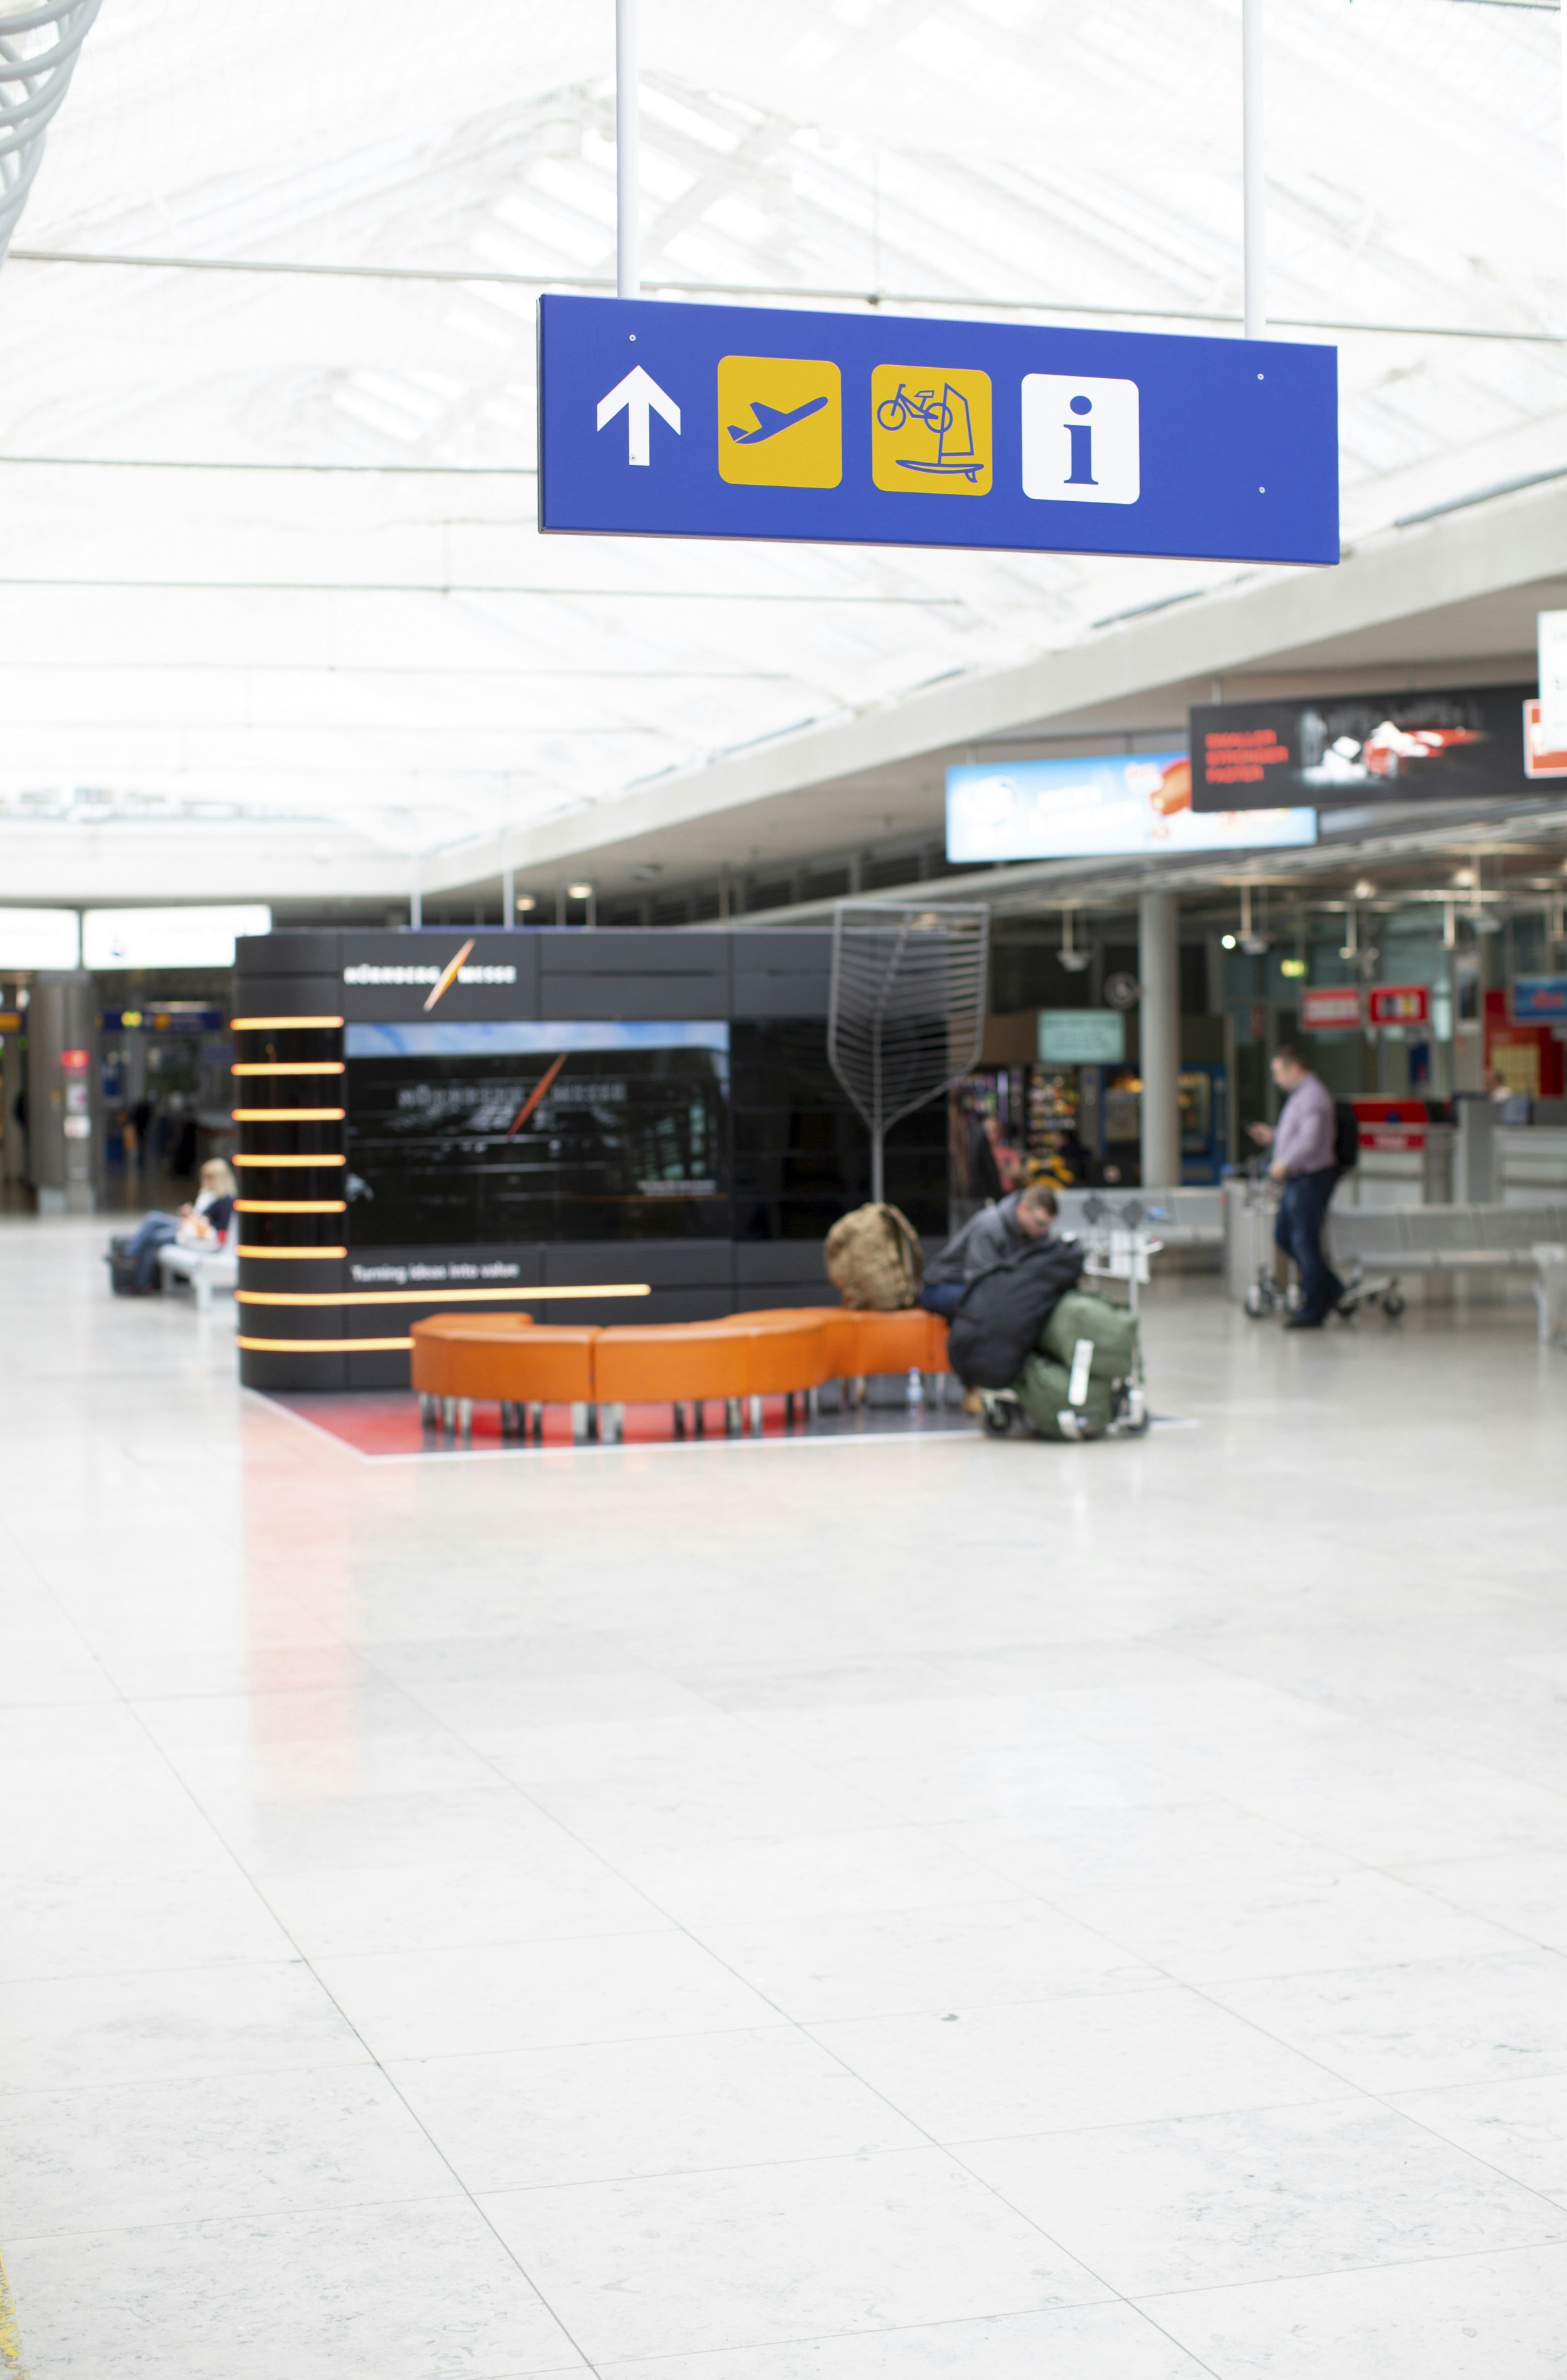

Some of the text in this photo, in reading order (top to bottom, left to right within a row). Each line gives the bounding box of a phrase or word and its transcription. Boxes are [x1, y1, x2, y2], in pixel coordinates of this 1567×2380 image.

[343, 963, 518, 985] NÜRNBERG MESSE
[397, 1083, 628, 1108] NÜRNBERG MESSE
[350, 1260, 520, 1285] Turning ideas into value
